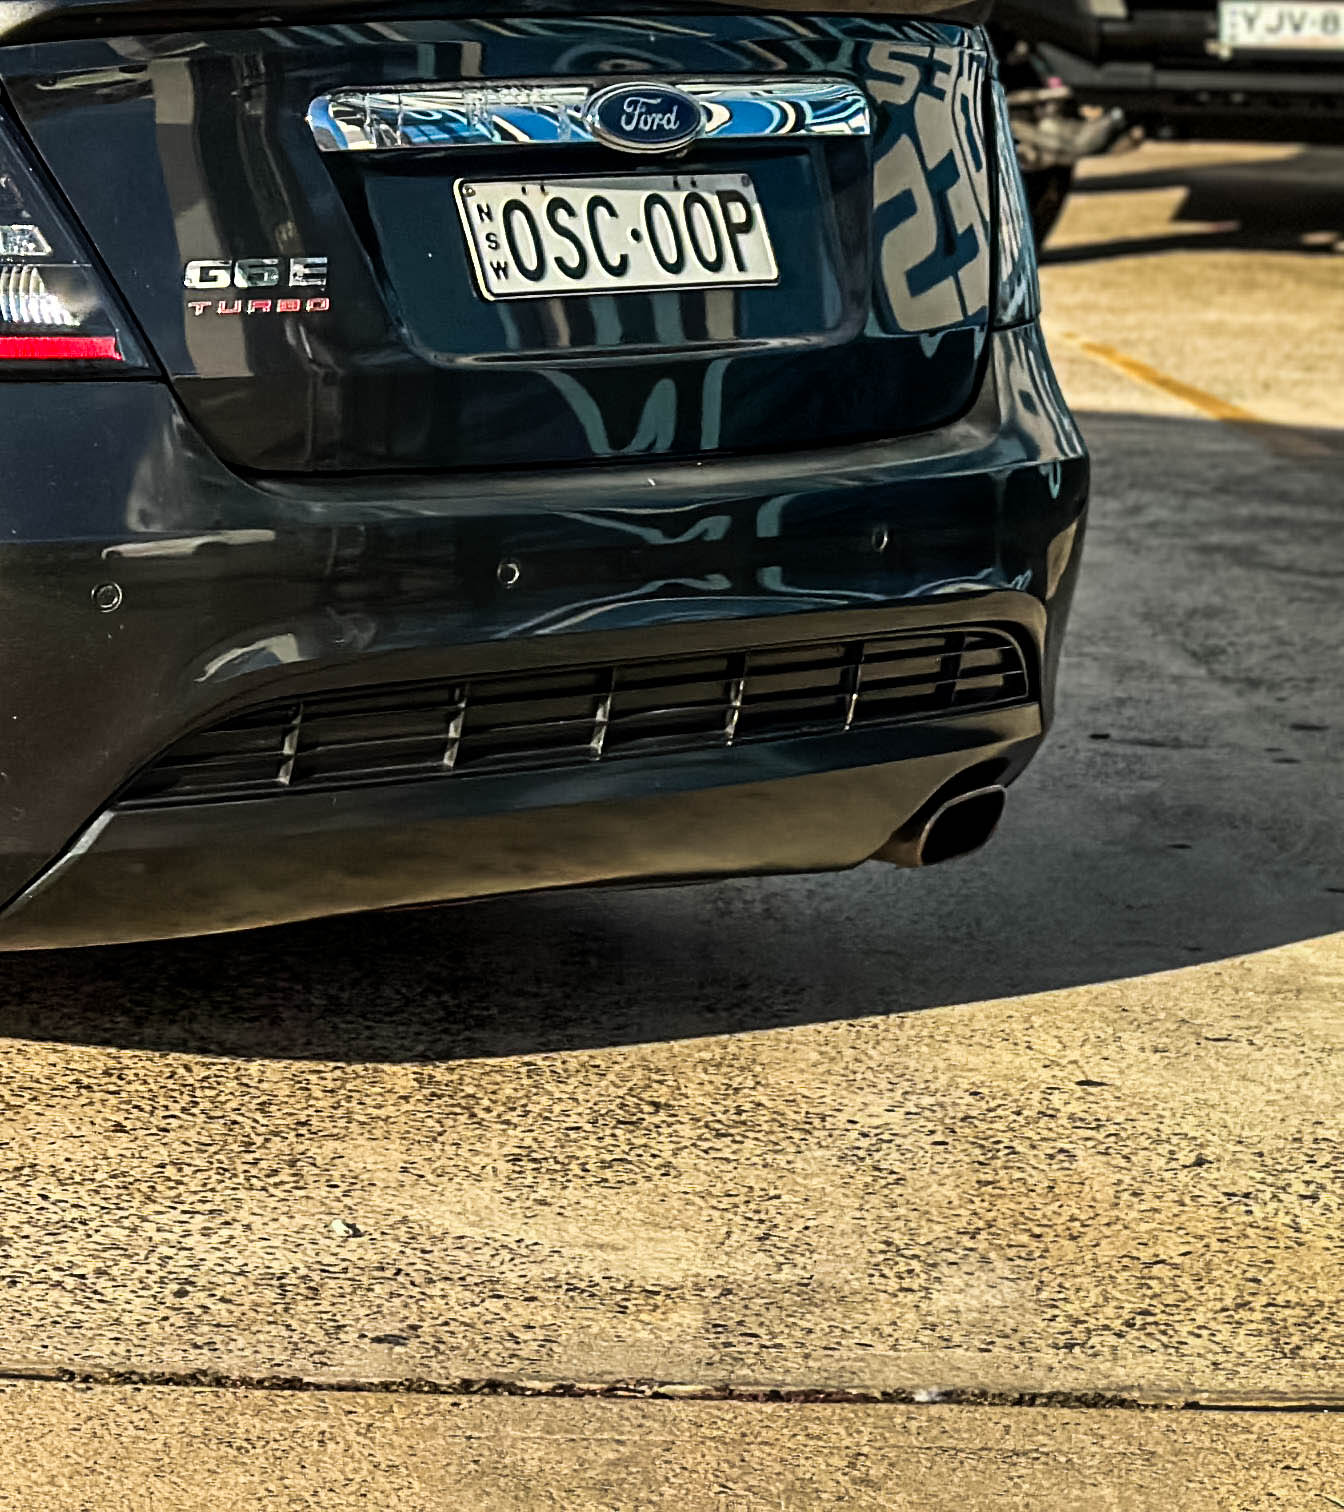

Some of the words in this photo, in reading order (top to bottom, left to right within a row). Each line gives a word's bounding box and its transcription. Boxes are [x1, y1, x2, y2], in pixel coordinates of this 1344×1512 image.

[620, 96, 680, 132] Ford
[183, 257, 328, 289] G6E
[187, 297, 330, 316] TURBO
